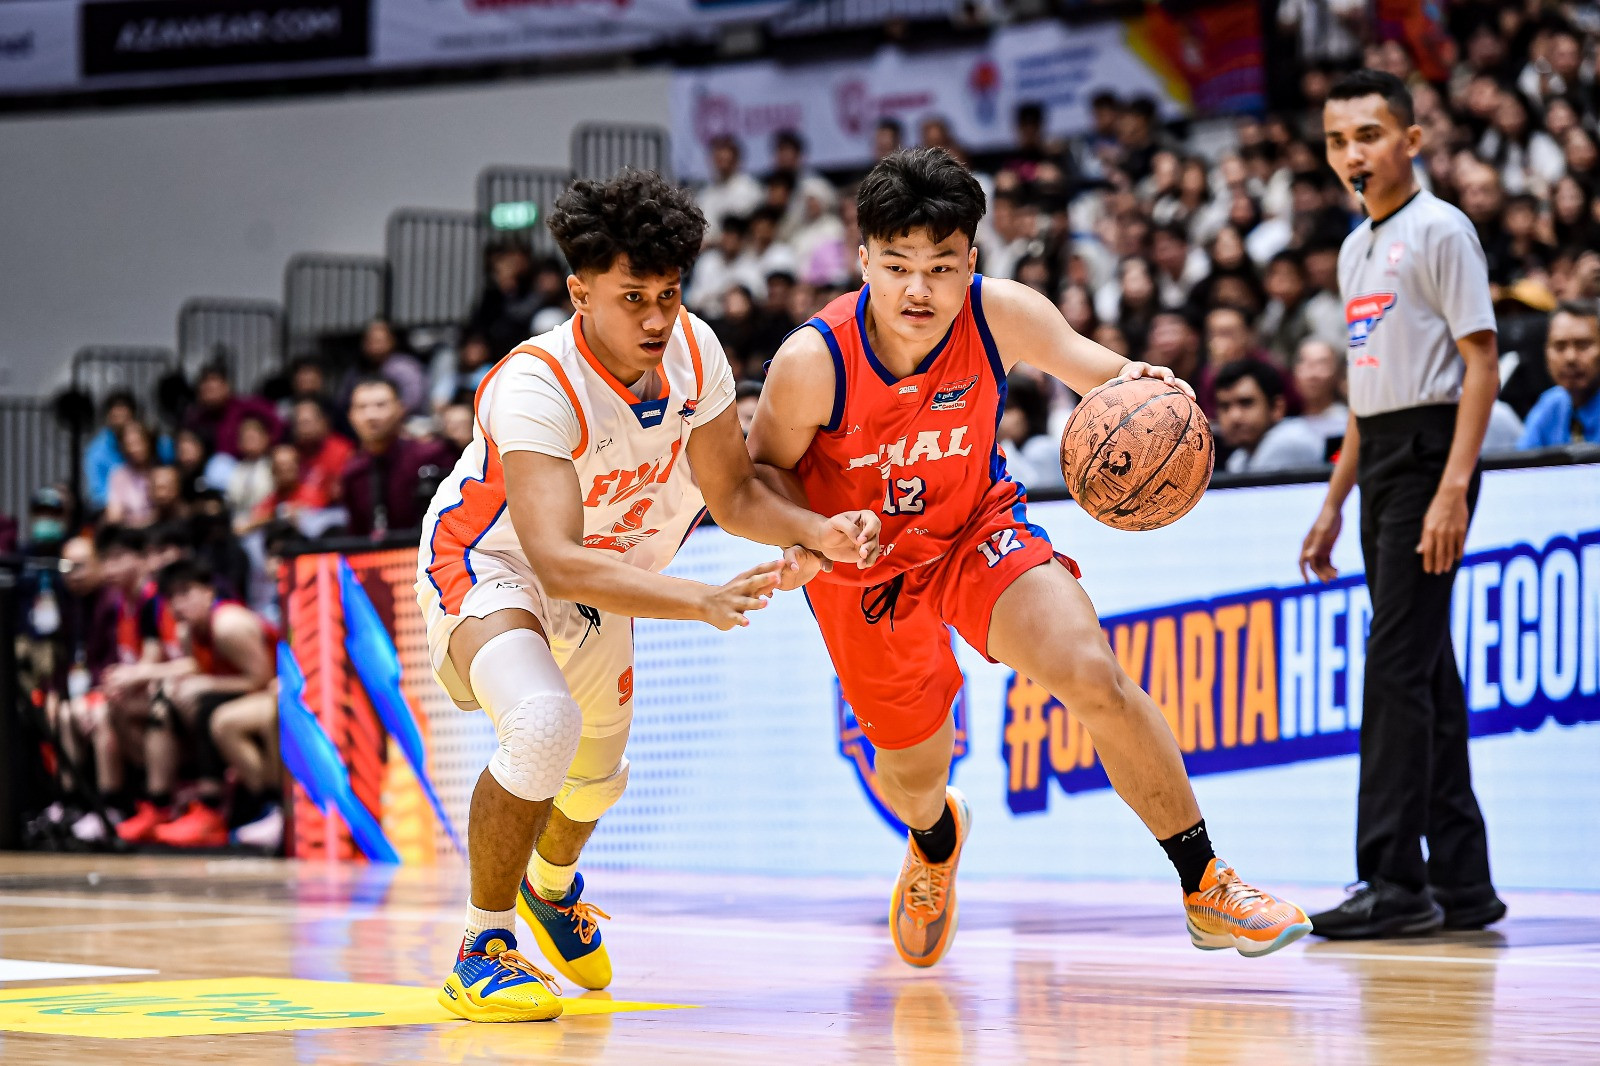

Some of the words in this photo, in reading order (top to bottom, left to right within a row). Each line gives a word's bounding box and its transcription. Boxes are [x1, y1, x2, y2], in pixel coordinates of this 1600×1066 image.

[881, 476, 926, 514] 12
[976, 528, 1025, 568] 12
[617, 665, 634, 706] 9
